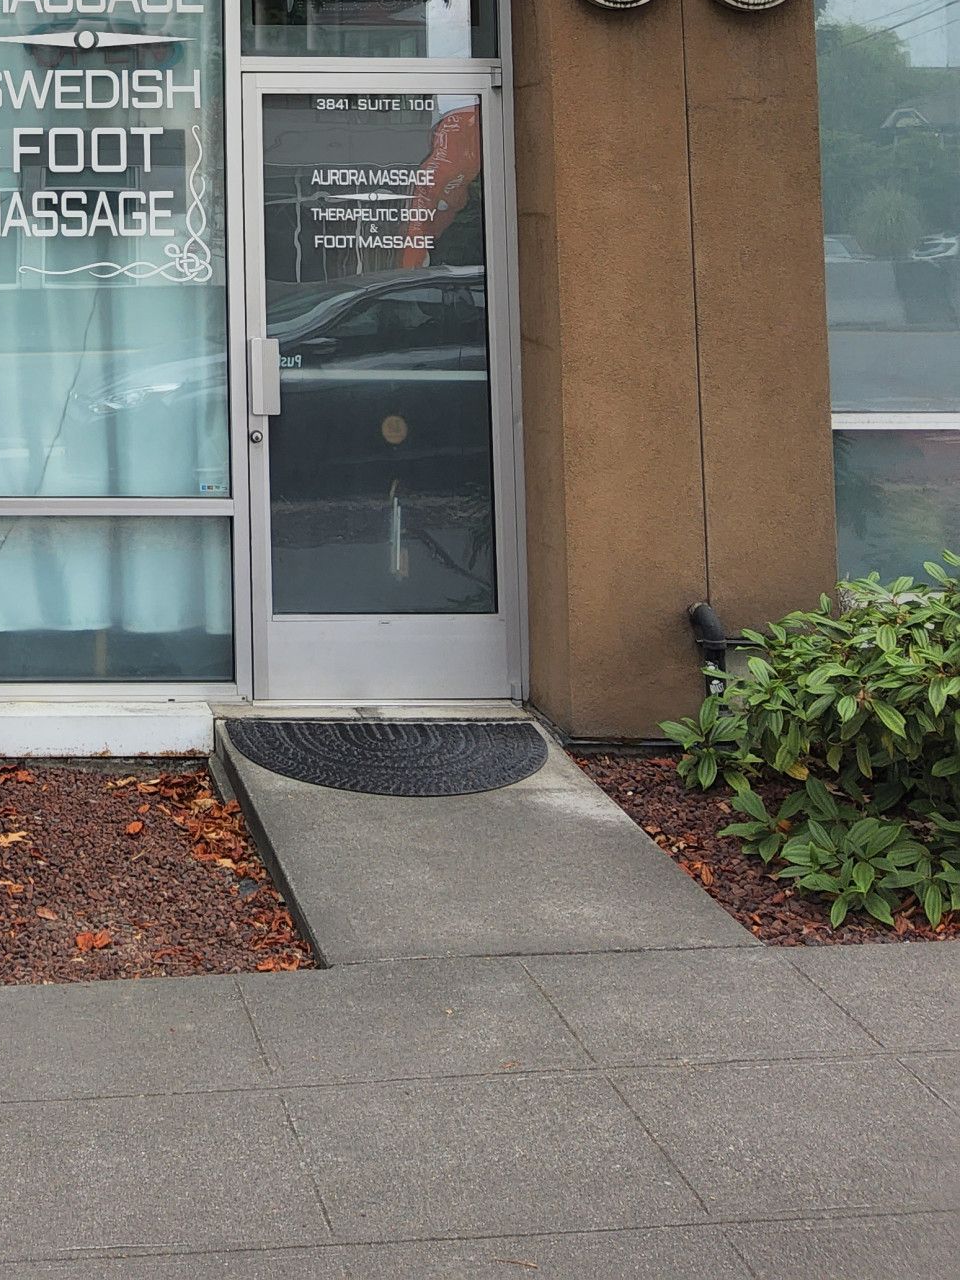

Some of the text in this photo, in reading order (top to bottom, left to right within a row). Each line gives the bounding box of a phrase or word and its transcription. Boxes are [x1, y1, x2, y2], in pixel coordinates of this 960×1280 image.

[316, 99, 434, 111] 3841 SUITE 100
[13, 127, 164, 173] FOOT
[311, 170, 435, 186] AURORA MASSAGE
[311, 208, 437, 222] THERAPEUTIC BODY
[370, 224, 378, 233] &
[315, 235, 435, 249] FOOT MASSAGE
